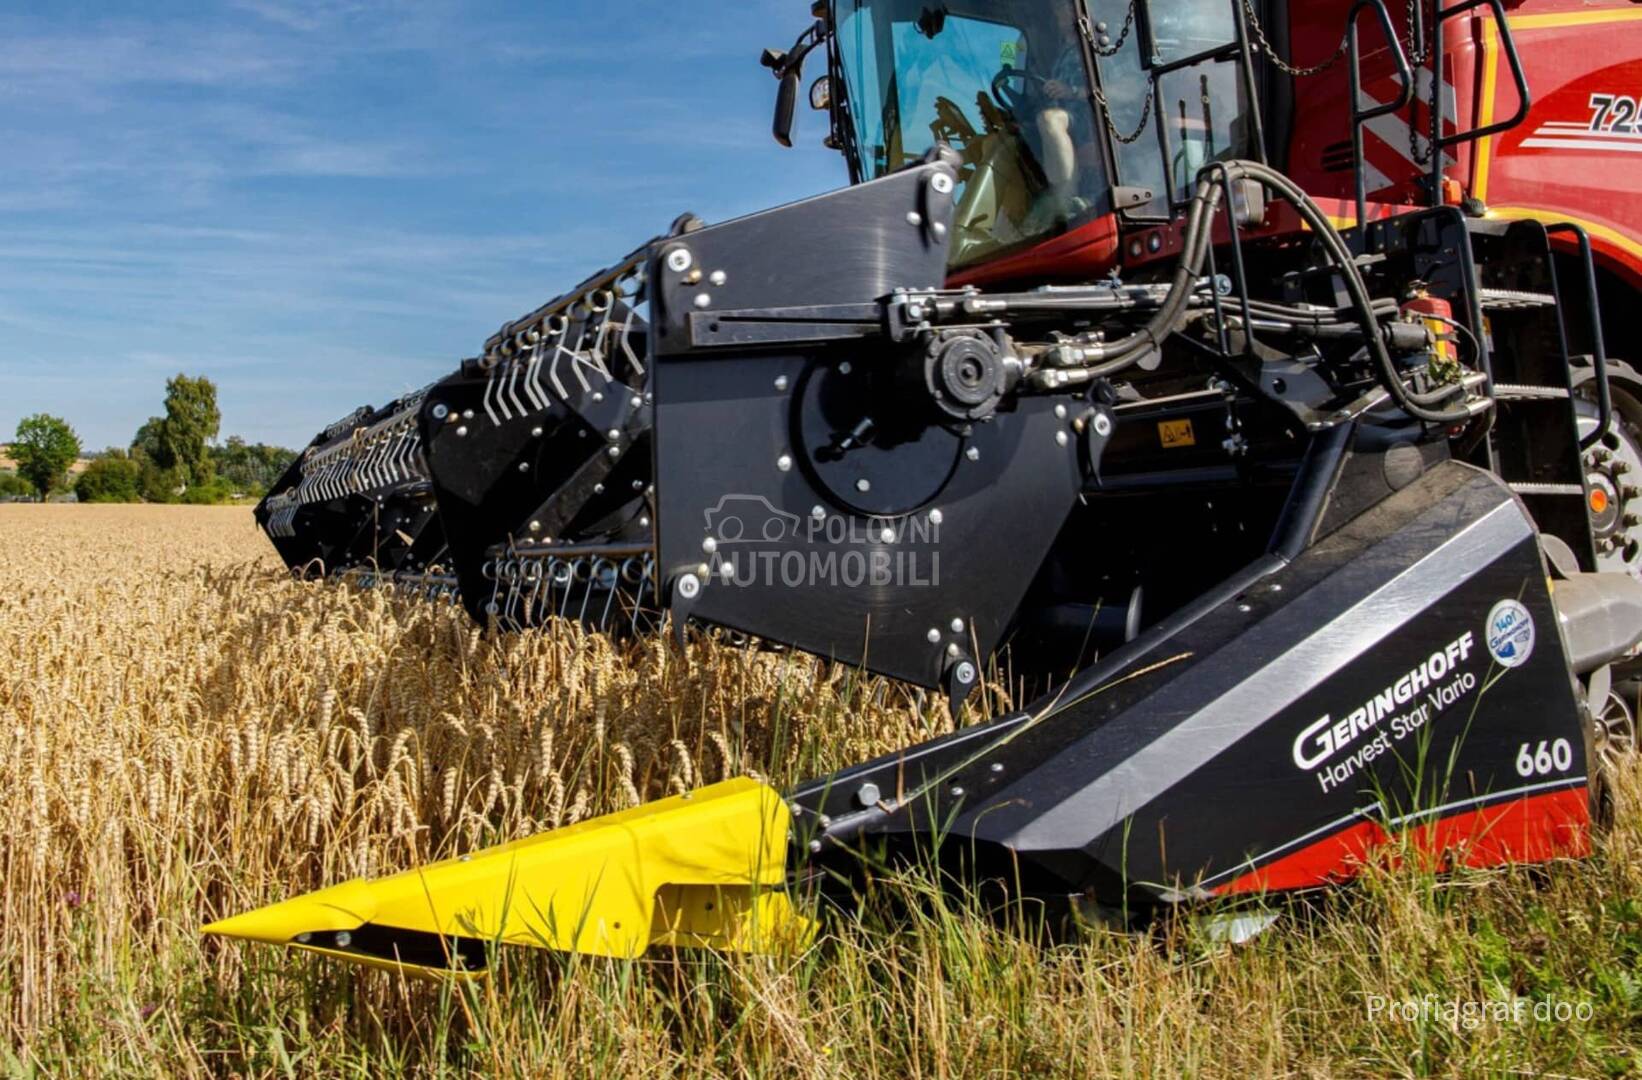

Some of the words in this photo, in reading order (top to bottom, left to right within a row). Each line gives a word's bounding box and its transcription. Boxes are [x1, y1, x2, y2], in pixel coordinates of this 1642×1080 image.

[1292, 630, 1475, 771] GERINGHOFF
[1316, 732, 1392, 794] Harvest
[1391, 705, 1430, 741] Star
[1428, 670, 1476, 713] Vario
[1515, 738, 1572, 777] 660
